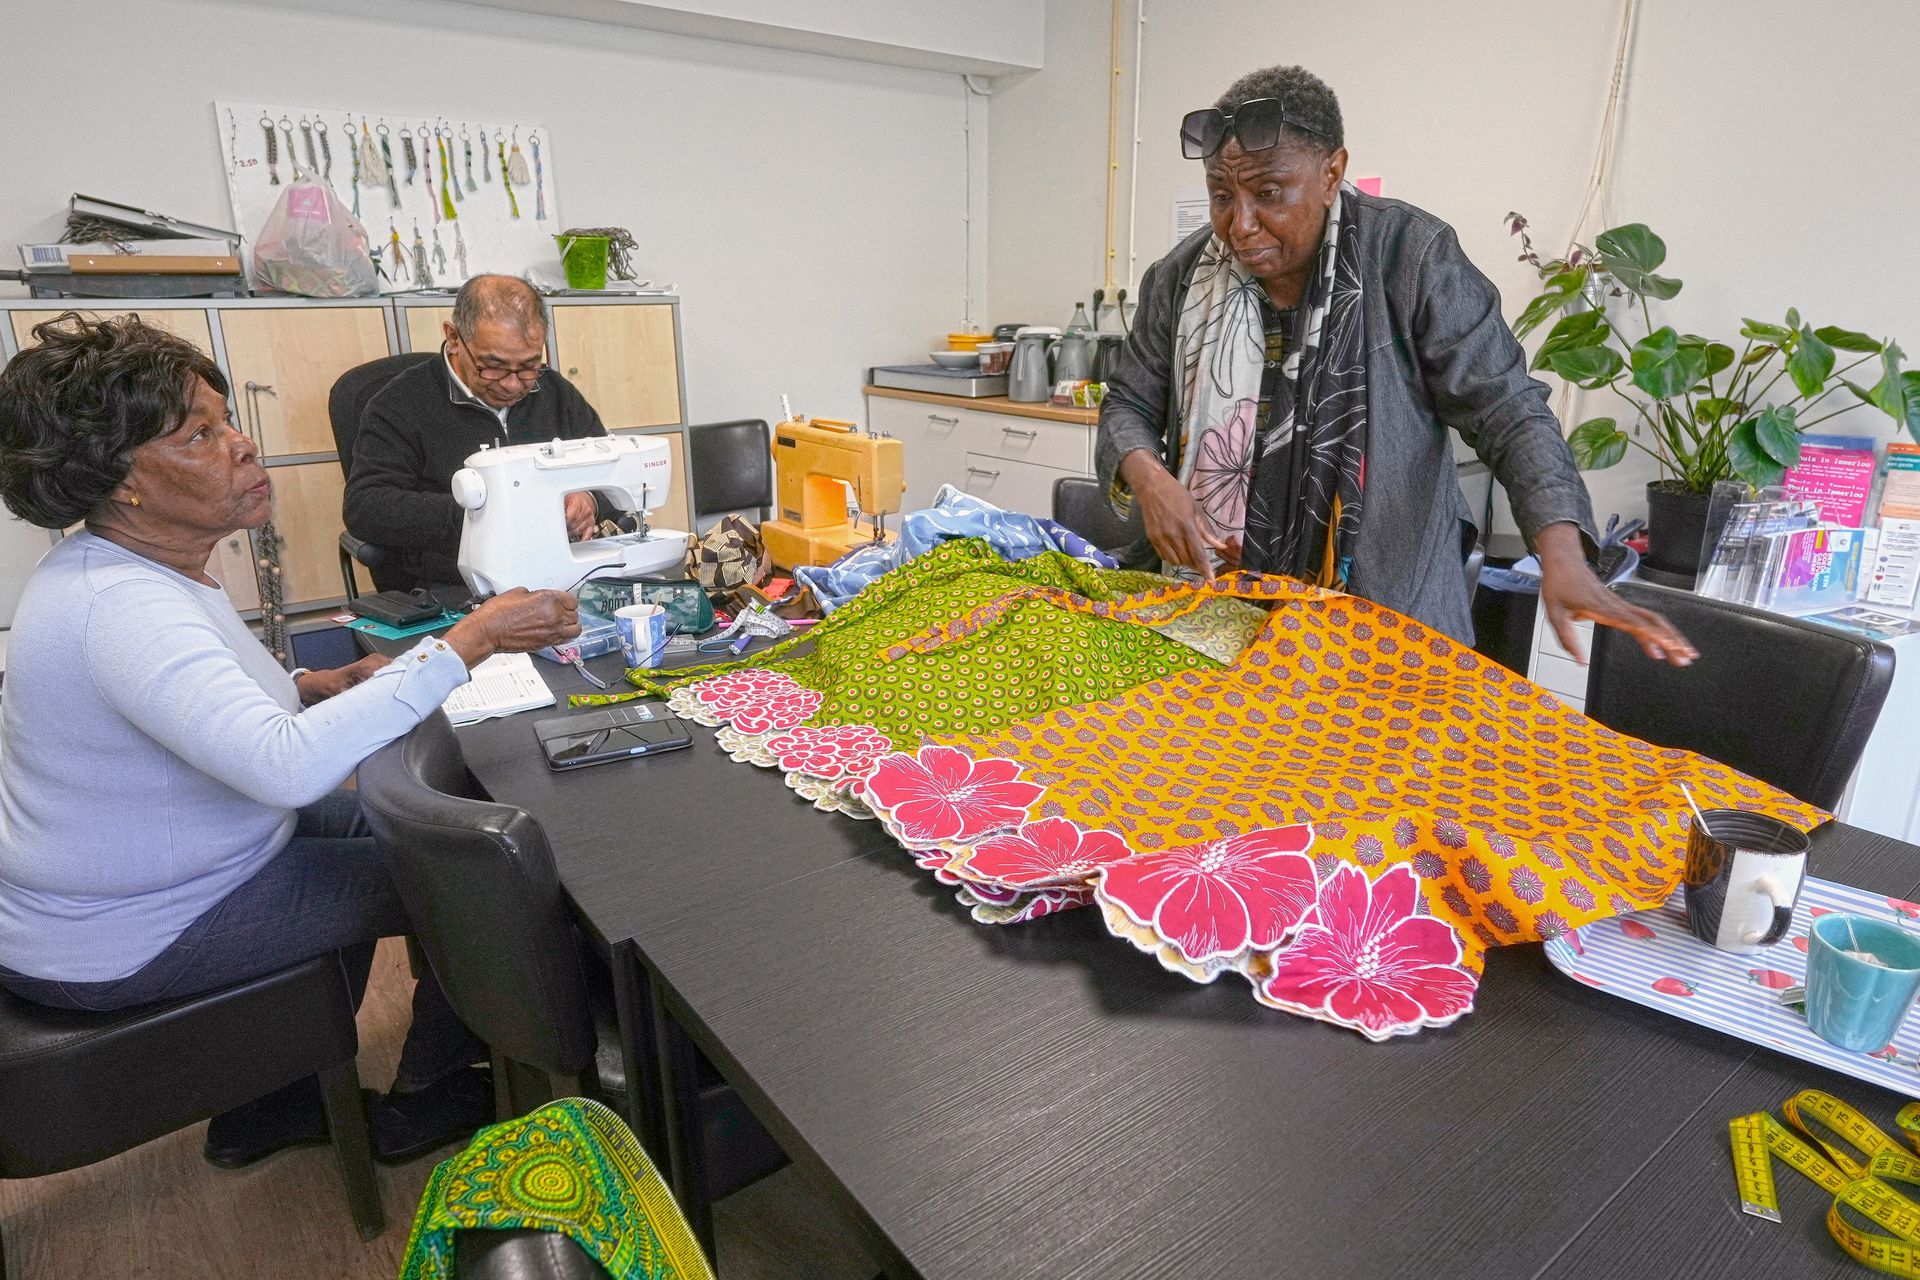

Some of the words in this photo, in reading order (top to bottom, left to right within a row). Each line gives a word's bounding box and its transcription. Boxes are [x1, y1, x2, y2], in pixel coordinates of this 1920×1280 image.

[239, 159, 258, 167] 2.50
[644, 459, 667, 469] SINGER
[1834, 458, 1871, 468] Immerloo
[1787, 483, 1809, 492] Thuis
[1827, 488, 1864, 498] Immerloo
[587, 1110, 611, 1135] INDIA
[1821, 1101, 1834, 1113] 74
[1837, 1111, 1849, 1124] 75
[1850, 1123, 1864, 1135] 76
[1866, 1135, 1879, 1147] 77
[609, 1133, 621, 1146] IN
[618, 1144, 640, 1175] MADE
[1893, 1160, 1907, 1173] 107
[1777, 1140, 1794, 1153] 139
[1809, 1162, 1826, 1176] 137
[1876, 1207, 1894, 1220] 133
[1894, 1215, 1912, 1230] 132
[1870, 1246, 1884, 1259] 32
[1891, 1250, 1905, 1263] 31
